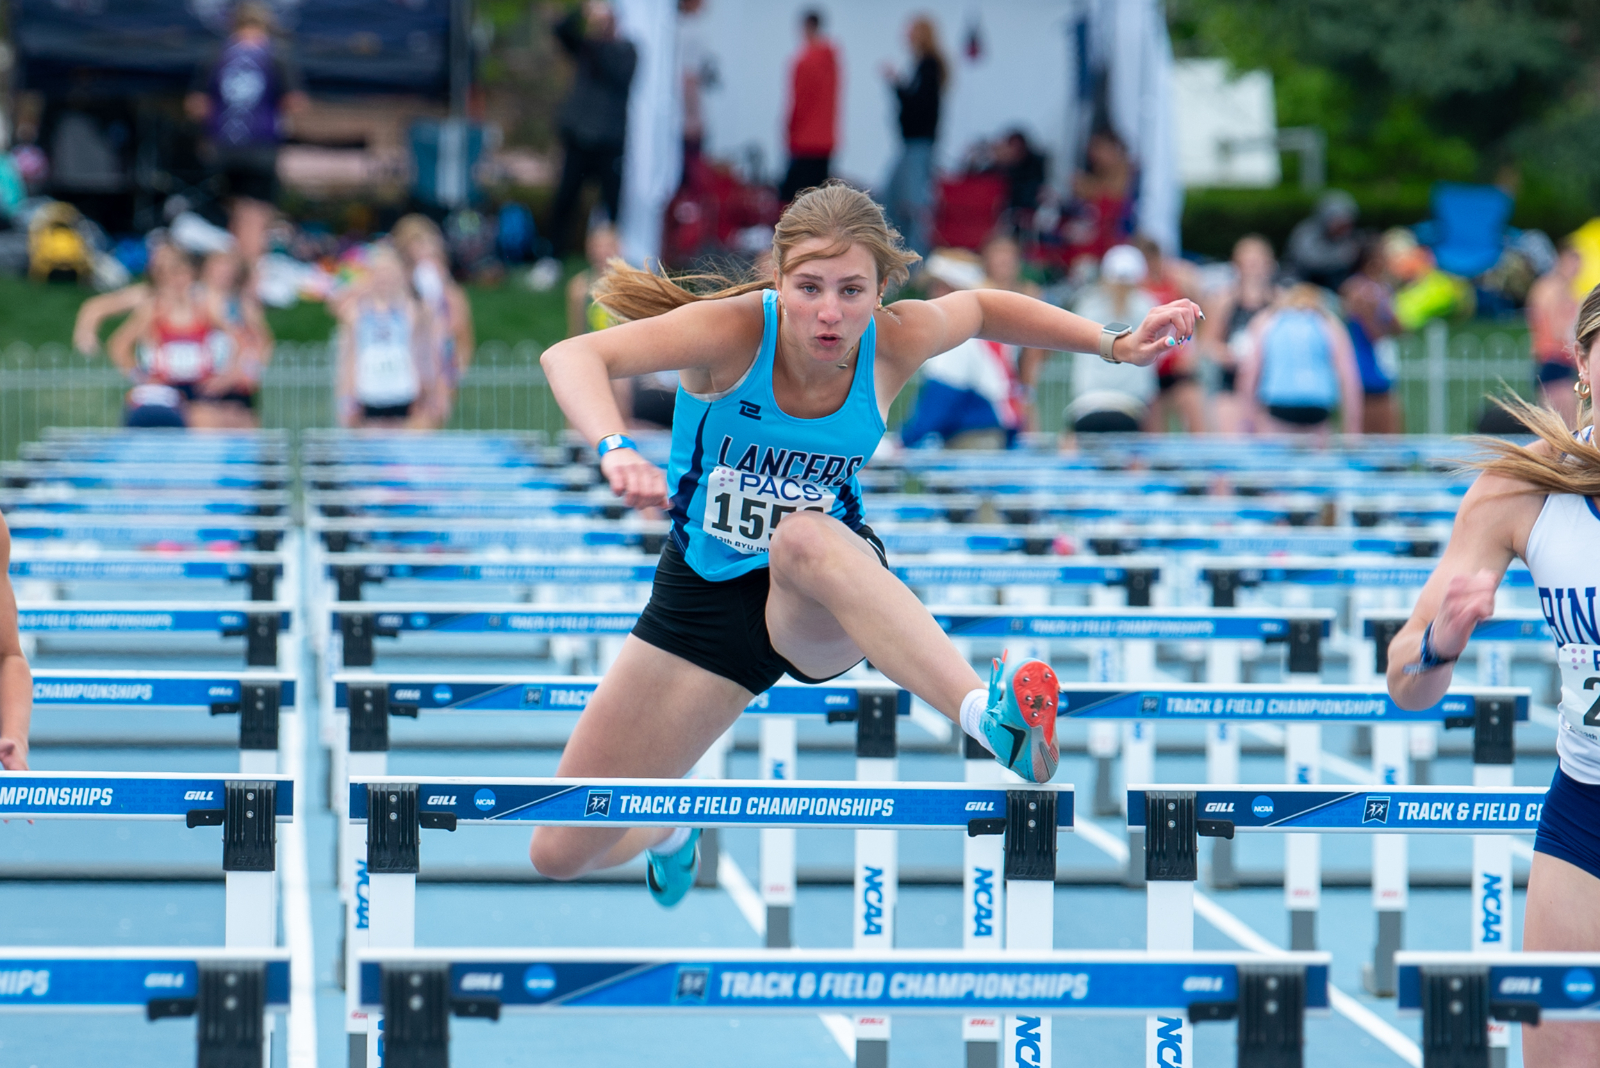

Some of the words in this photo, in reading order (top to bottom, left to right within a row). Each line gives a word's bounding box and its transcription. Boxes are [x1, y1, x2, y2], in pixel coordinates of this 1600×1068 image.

[718, 434, 865, 487] LANCERS
[739, 472, 823, 502] PACS
[711, 492, 825, 541] 155
[734, 541, 754, 551] BYU
[33, 682, 153, 701] CHAMPIONSHIPS
[1165, 697, 1211, 714] TRACK
[1225, 698, 1264, 715] FIELD
[1267, 699, 1387, 716] CHAMPIONSHIPS
[183, 790, 214, 801] GILL
[426, 795, 457, 806] GILL
[620, 795, 677, 814] TRACK
[678, 796, 691, 815] &
[694, 796, 742, 815] FIELD
[745, 797, 895, 817] CHAMPIONSHIPS
[964, 801, 995, 812] GILL
[1204, 802, 1235, 813] GILL
[1398, 802, 1455, 820] TRACK
[1456, 803, 1470, 821] &
[1472, 803, 1521, 822] FIELD
[863, 866, 883, 935] NCAA
[973, 867, 994, 937] NCAA
[1482, 873, 1502, 943] NCAA
[719, 971, 796, 998] TRACK
[798, 972, 816, 998] &
[819, 972, 885, 999] FIELD
[889, 973, 1090, 1000] CHAMPIONSHIPS
[1016, 1014, 1042, 1068] NC
[1157, 1015, 1183, 1068] NC
